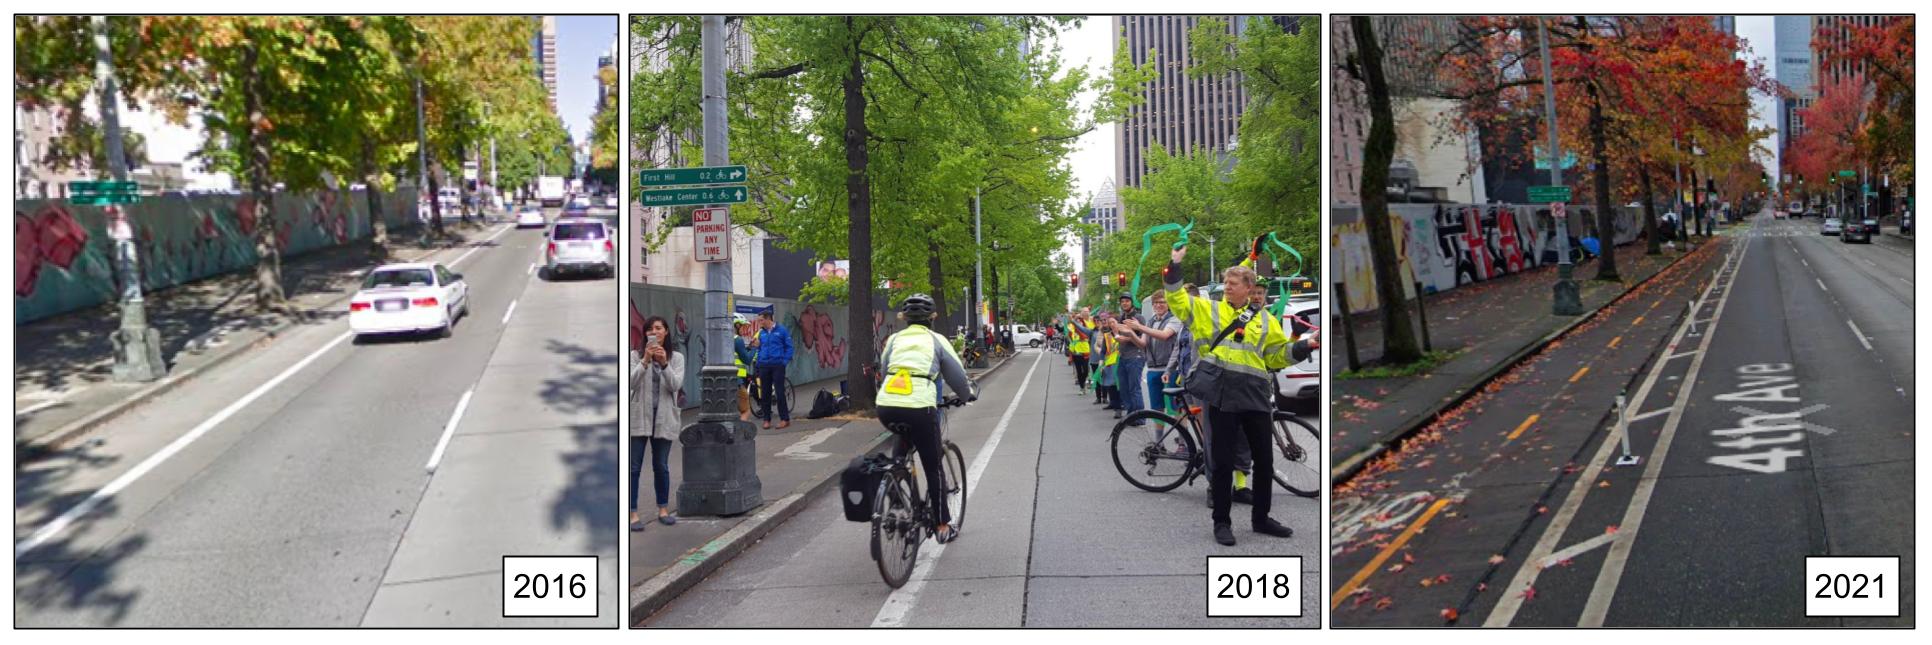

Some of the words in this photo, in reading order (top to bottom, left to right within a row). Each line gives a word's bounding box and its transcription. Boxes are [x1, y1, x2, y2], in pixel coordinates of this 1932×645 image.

[699, 172, 711, 180] 0.2
[646, 194, 673, 202] Westlake
[677, 193, 698, 201] Center
[702, 192, 714, 200] 0.6
[695, 211, 710, 220] NO
[696, 224, 725, 233] PARKING
[704, 236, 718, 244] ANY
[703, 247, 721, 255] TIME
[1712, 362, 1801, 402] Ave
[1705, 411, 1805, 474] 4th
